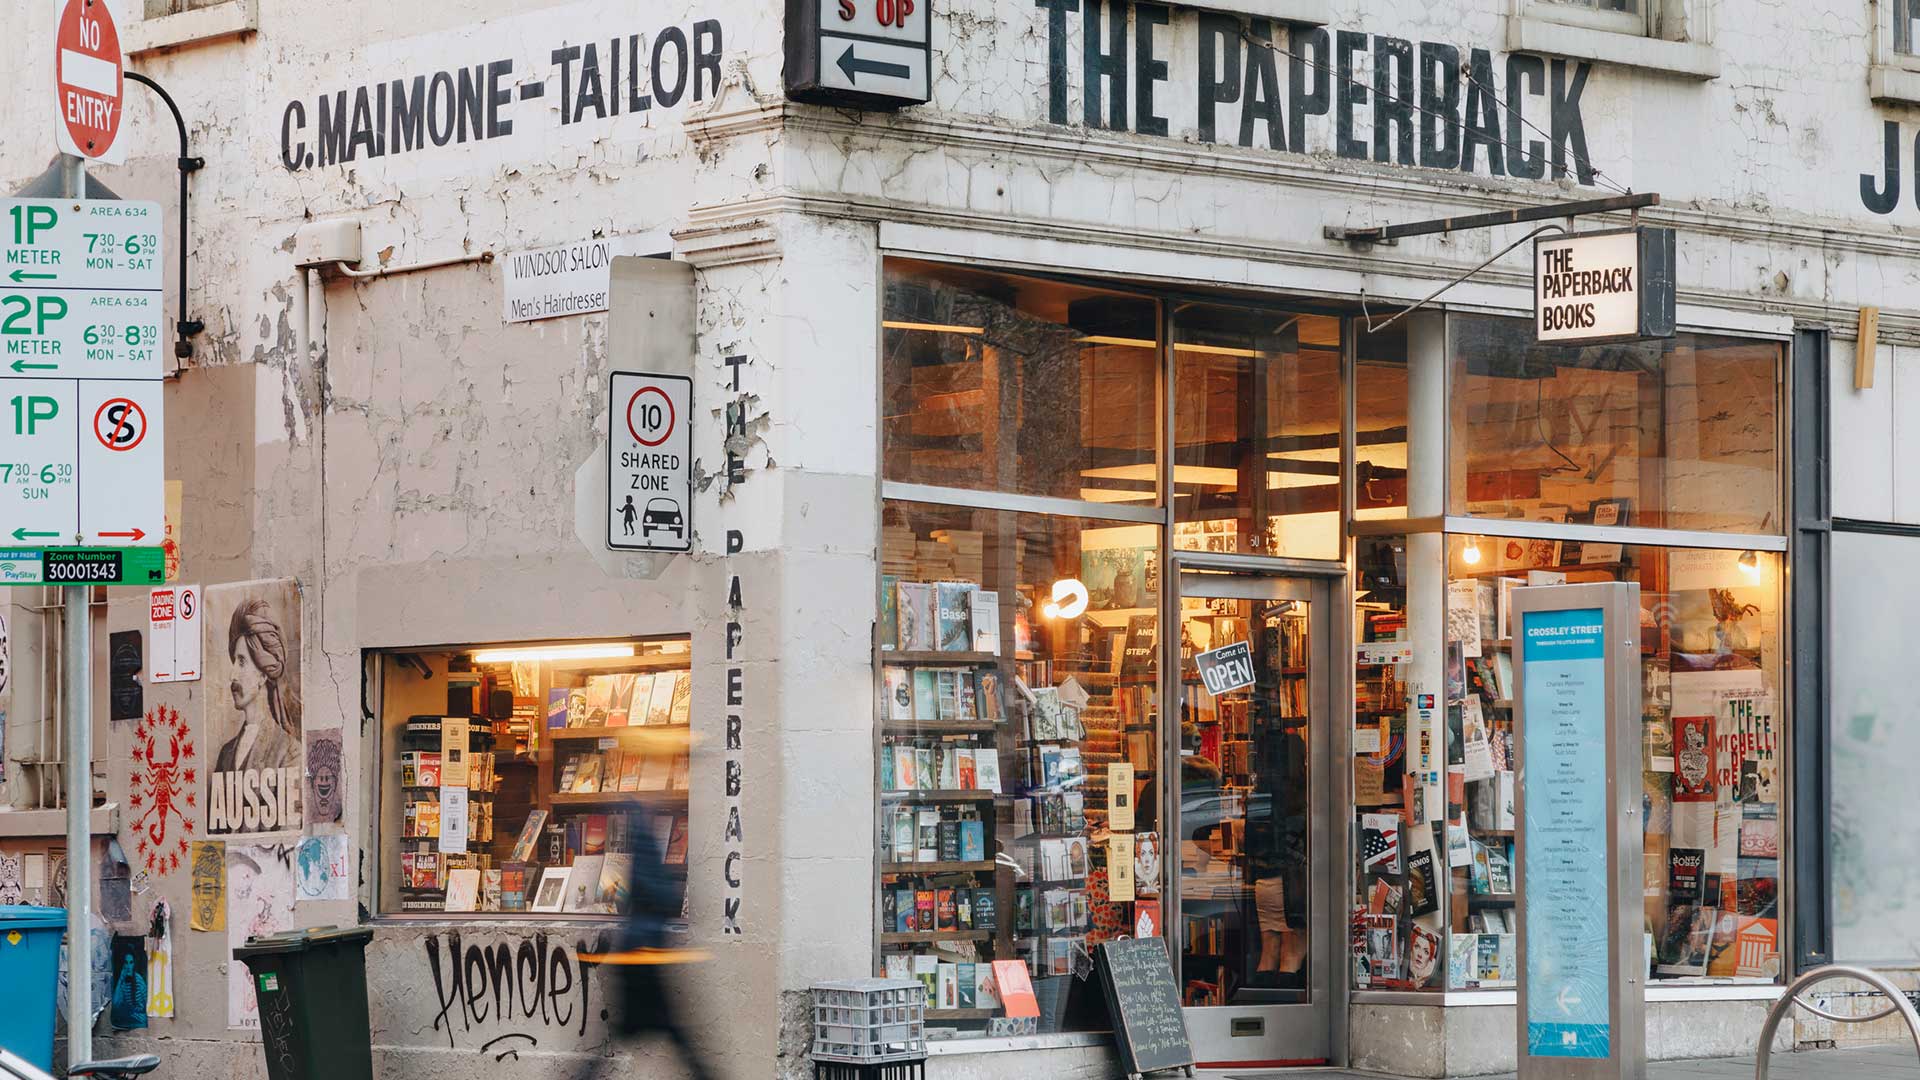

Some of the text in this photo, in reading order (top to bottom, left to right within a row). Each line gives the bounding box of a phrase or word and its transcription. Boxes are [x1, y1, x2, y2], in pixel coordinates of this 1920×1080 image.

[80, 16, 100, 51] NO
[1036, 0, 1595, 186] THE PAPERBACK
[67, 91, 114, 132] ENTRY
[90, 208, 147, 217] AREA 634
[10, 205, 58, 245] 1P
[7, 250, 61, 265] METER
[86, 259, 114, 269] MON
[128, 259, 153, 270] SAT
[512, 242, 611, 280] WINDSOR SALON
[1542, 248, 1574, 275] THE
[1542, 266, 1633, 300] PAPERBACK
[90, 297, 148, 307] AREA 634
[511, 292, 607, 318] Men's Hairdresser
[1, 295, 69, 336] 2P
[1542, 303, 1596, 332] BOOKS
[7, 340, 61, 355] METER
[86, 349, 114, 361] MON
[128, 350, 153, 361] SAT
[10, 395, 59, 435] 1P
[640, 404, 662, 431] 10
[621, 452, 680, 471] SHARED
[631, 474, 669, 491] ZONE
[22, 488, 49, 499] SUN
[50, 552, 116, 561] Zone Number
[5, 570, 37, 580] PayStay
[48, 562, 117, 580] 30001343
[152, 594, 174, 607] LOADING
[152, 605, 173, 618] ZONE
[1528, 625, 1603, 637] CROSSLEY STREET
[1215, 645, 1247, 660] Come in
[1206, 657, 1252, 691] OPEN
[1729, 700, 1753, 717] THE
[724, 529, 745, 935] PAPERBACK
[1739, 715, 1771, 734] LIFE
[208, 766, 302, 830] AUSSIE
